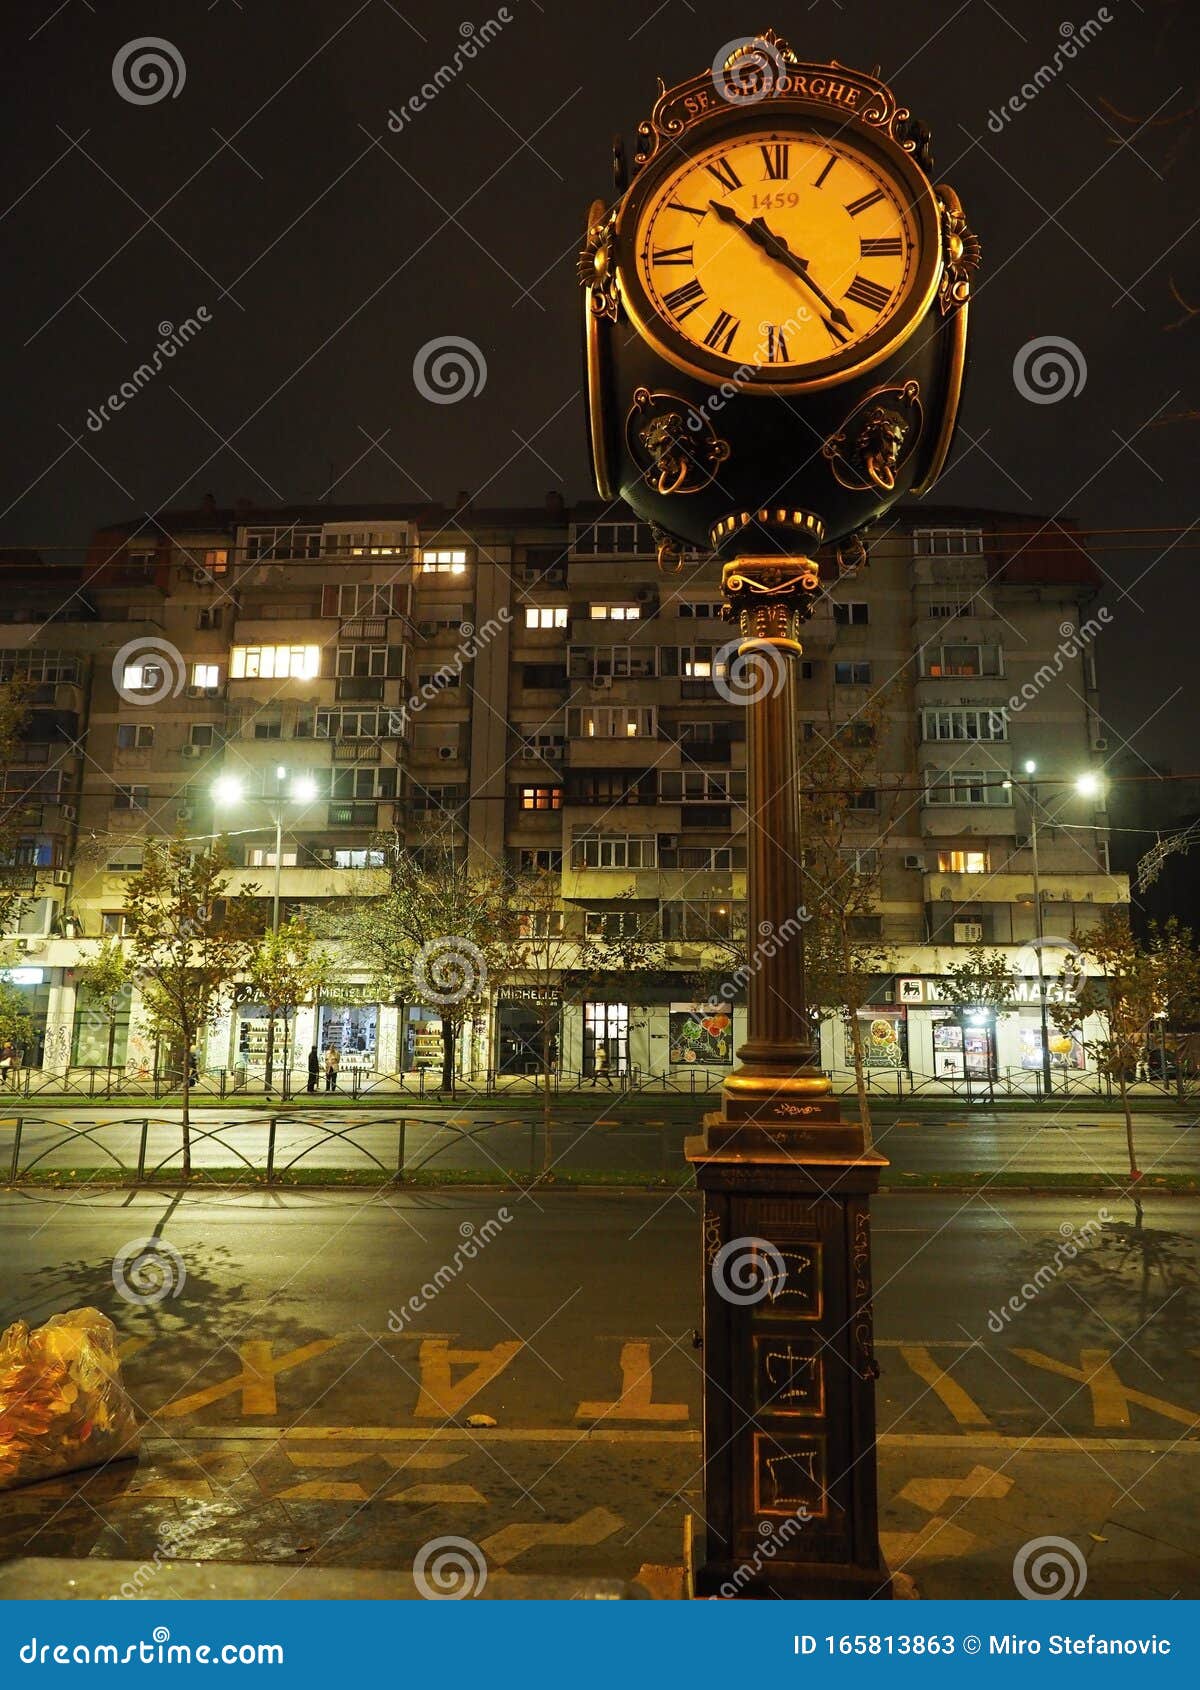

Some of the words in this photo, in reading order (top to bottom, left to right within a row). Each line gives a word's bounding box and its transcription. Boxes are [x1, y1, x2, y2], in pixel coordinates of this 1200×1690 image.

[684, 91, 716, 113] SF.
[723, 75, 861, 105] GHEORGHE
[702, 154, 746, 198] XI
[760, 144, 792, 181] XII
[751, 193, 800, 210] 1459
[148, 1337, 690, 1421] TAX
